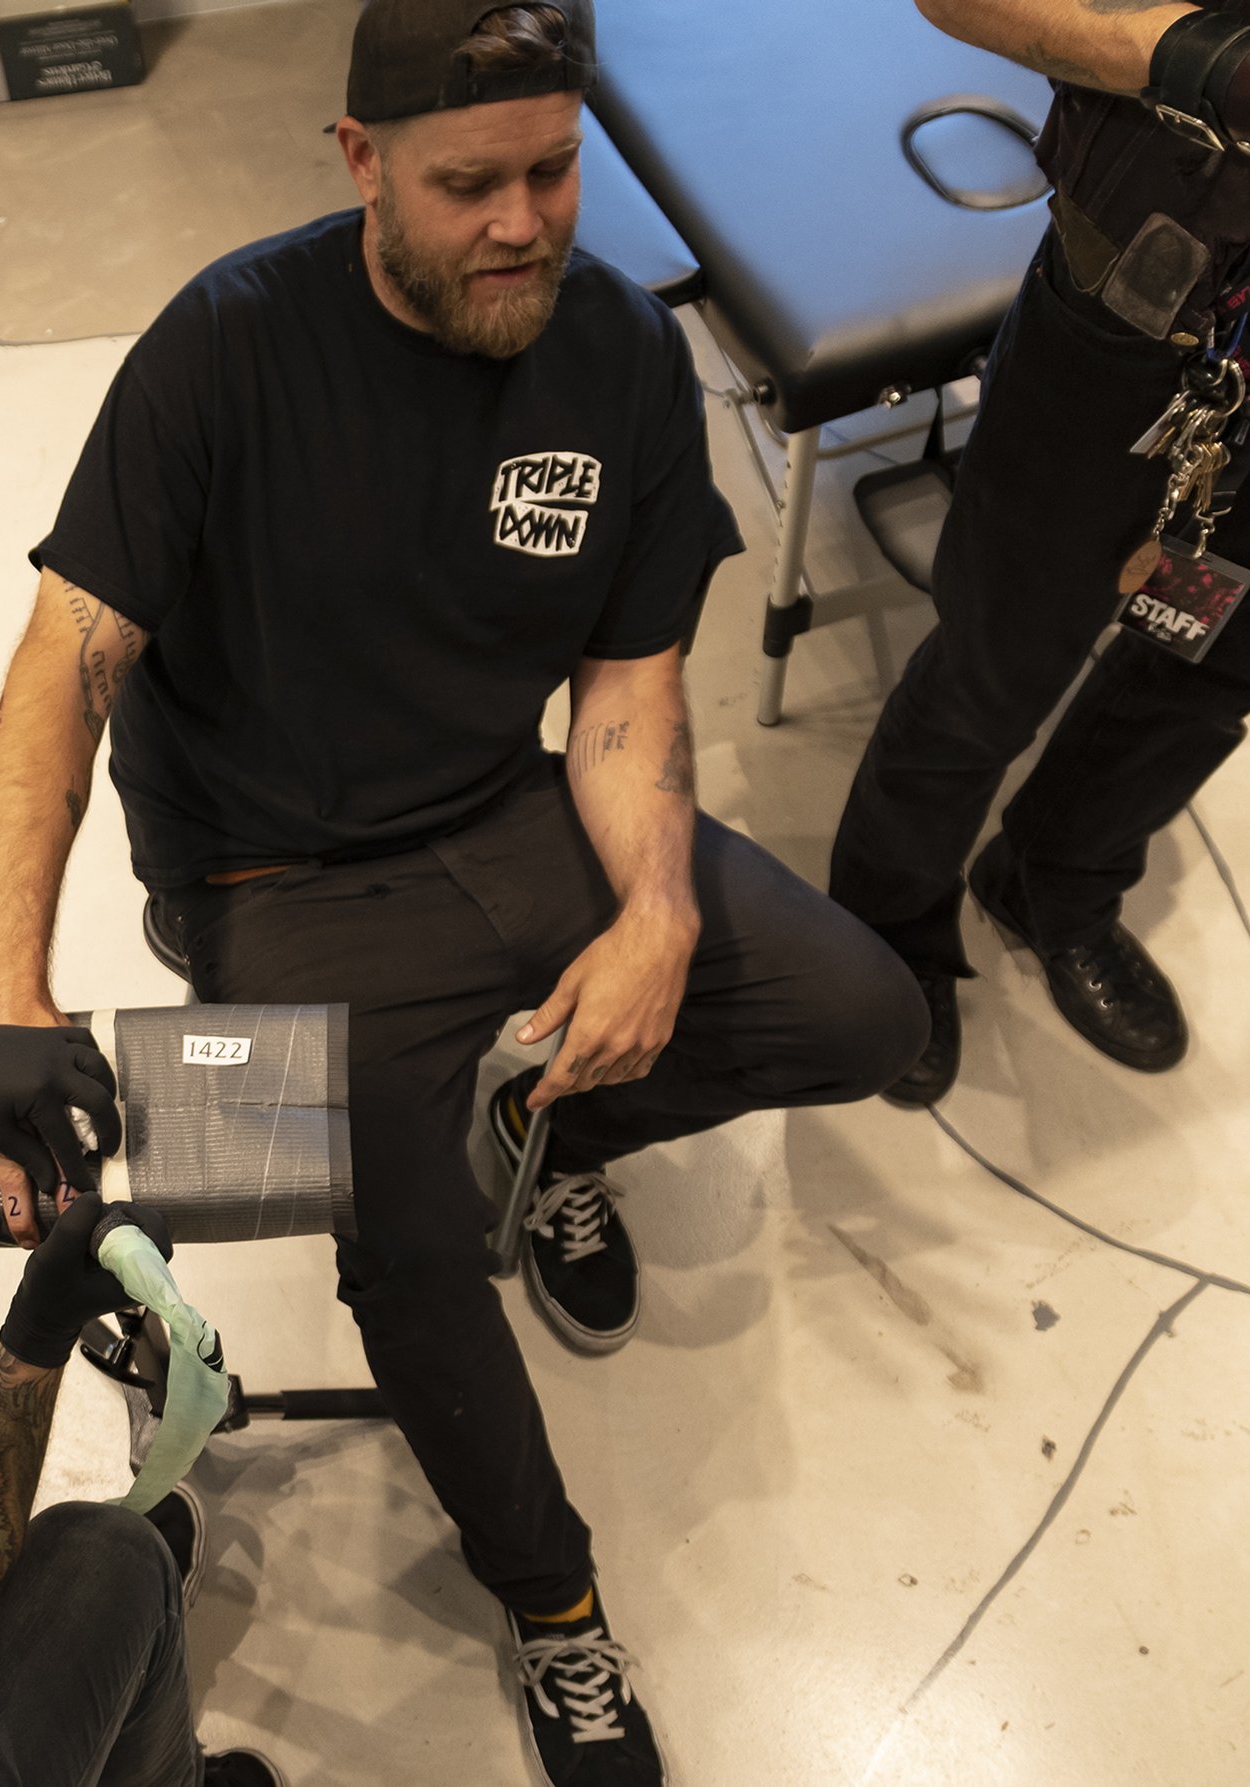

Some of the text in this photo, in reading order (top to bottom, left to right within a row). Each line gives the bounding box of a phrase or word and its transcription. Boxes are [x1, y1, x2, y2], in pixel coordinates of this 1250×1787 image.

[498, 454, 597, 502] TRIPLE
[499, 504, 582, 552] DOWN
[1131, 593, 1210, 641] STAFF
[190, 1041, 243, 1059] 1422
[8, 1196, 21, 1217] 2
